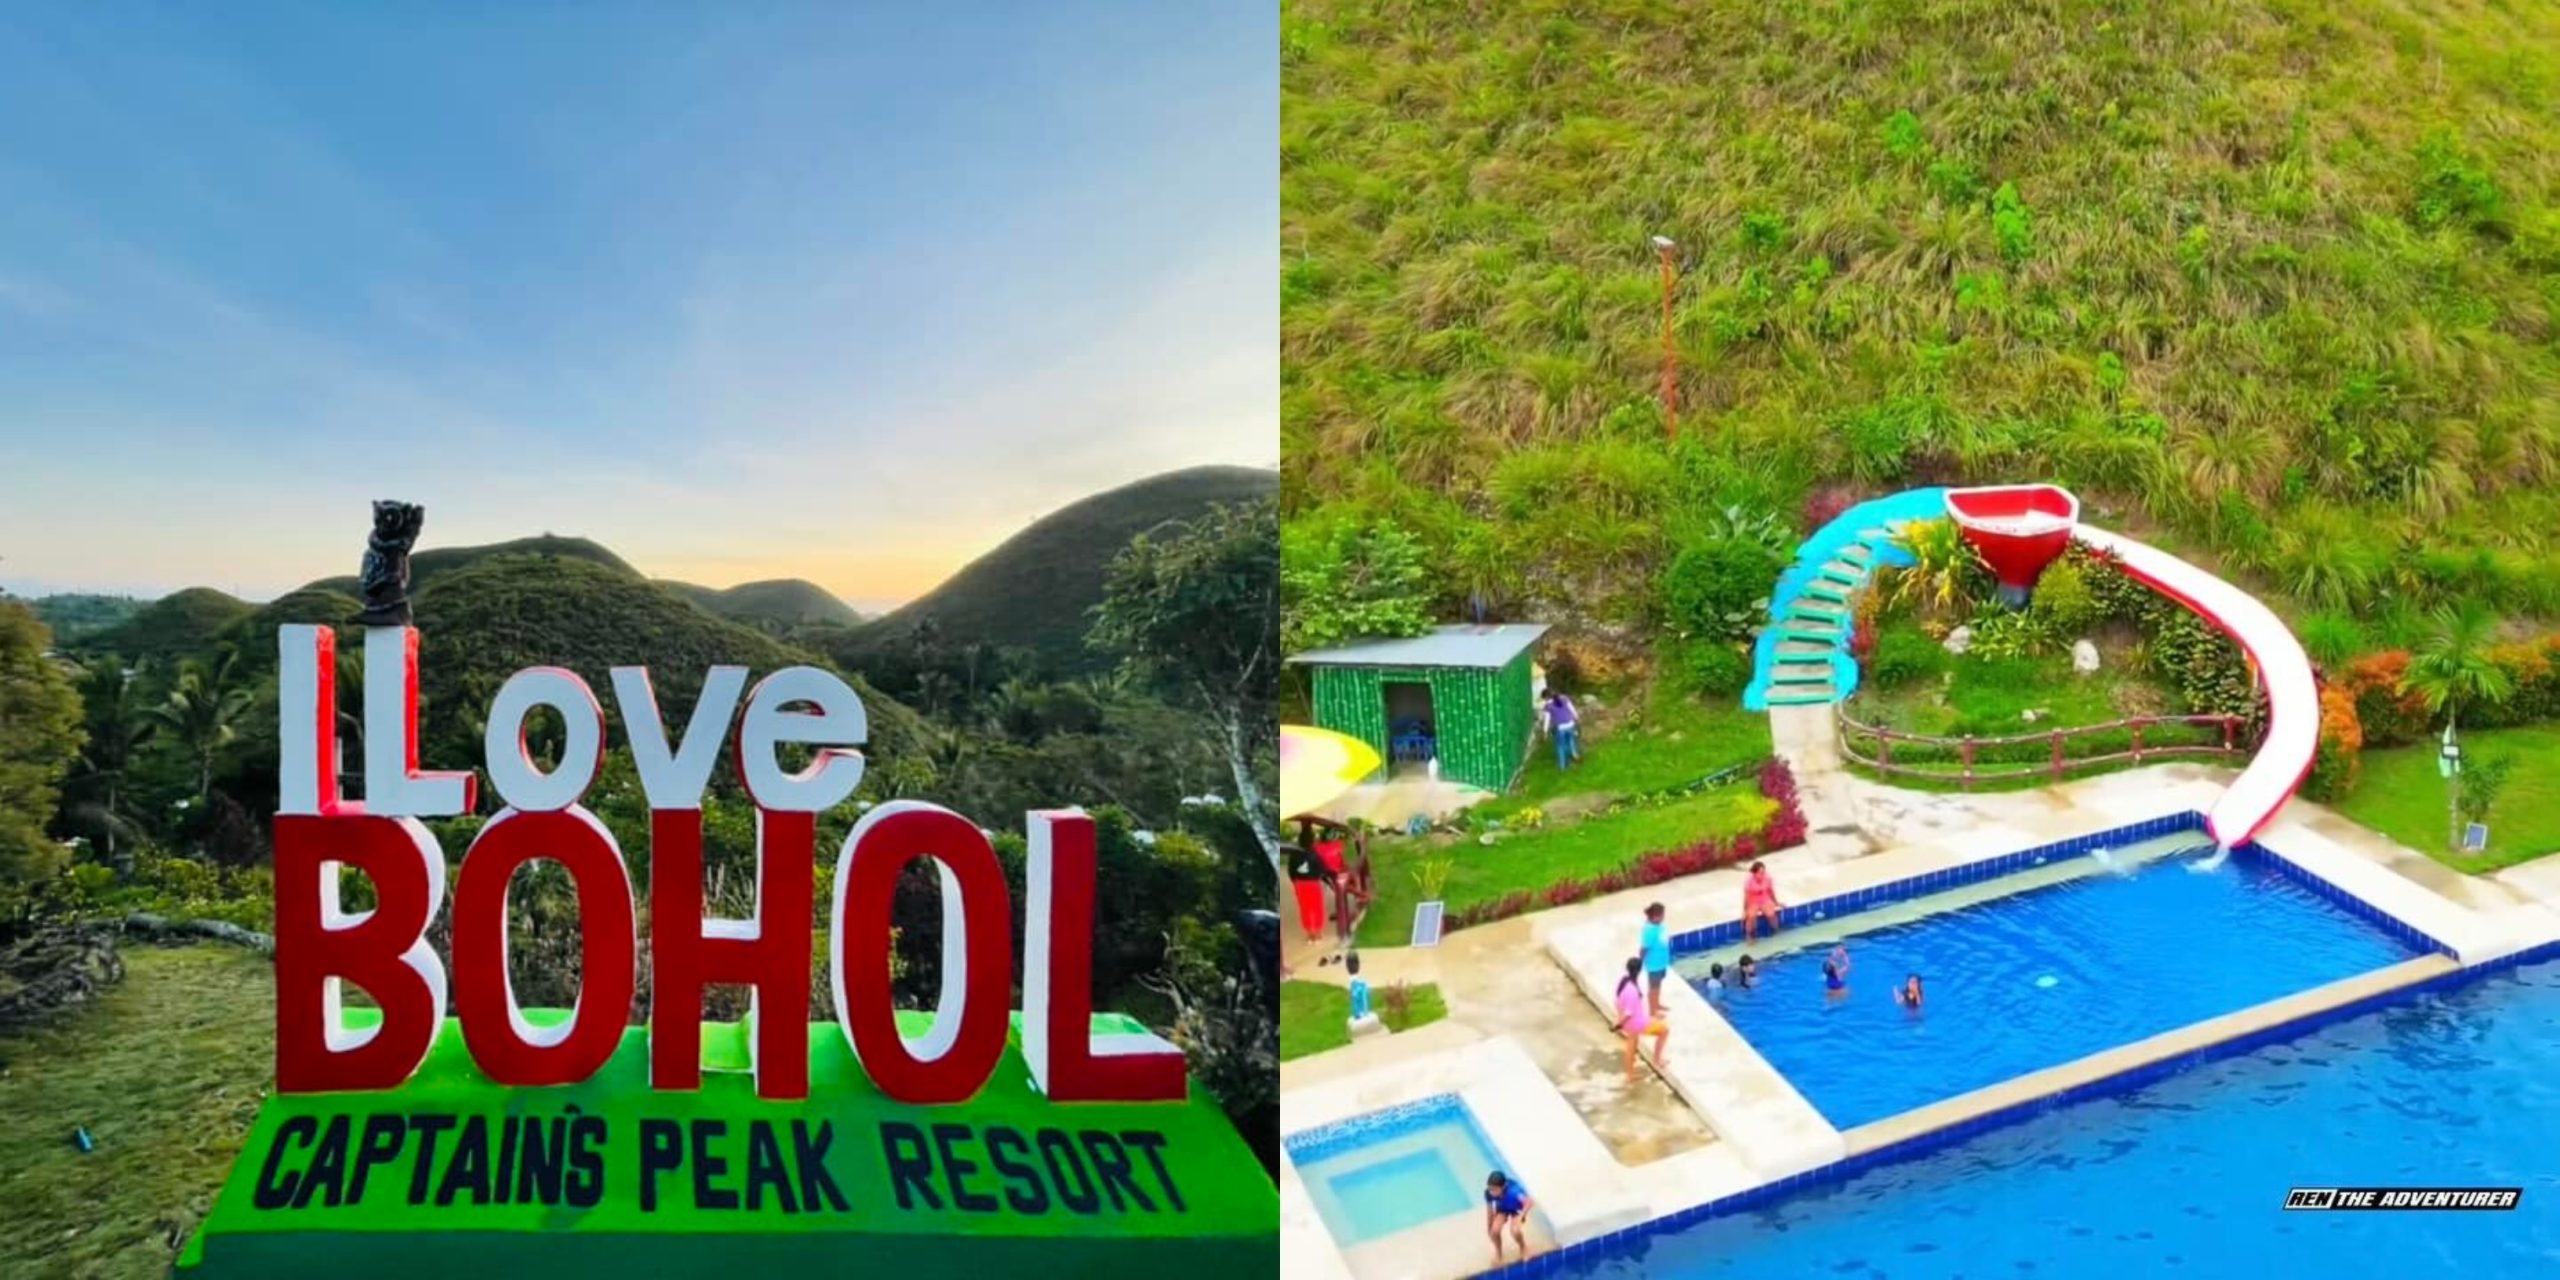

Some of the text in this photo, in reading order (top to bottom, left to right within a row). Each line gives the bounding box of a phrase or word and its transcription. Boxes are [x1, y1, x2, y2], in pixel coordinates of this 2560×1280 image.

[274, 800, 1186, 1101] BOHOL
[639, 1118, 851, 1214] PEAK
[879, 1121, 1189, 1215] RESORT
